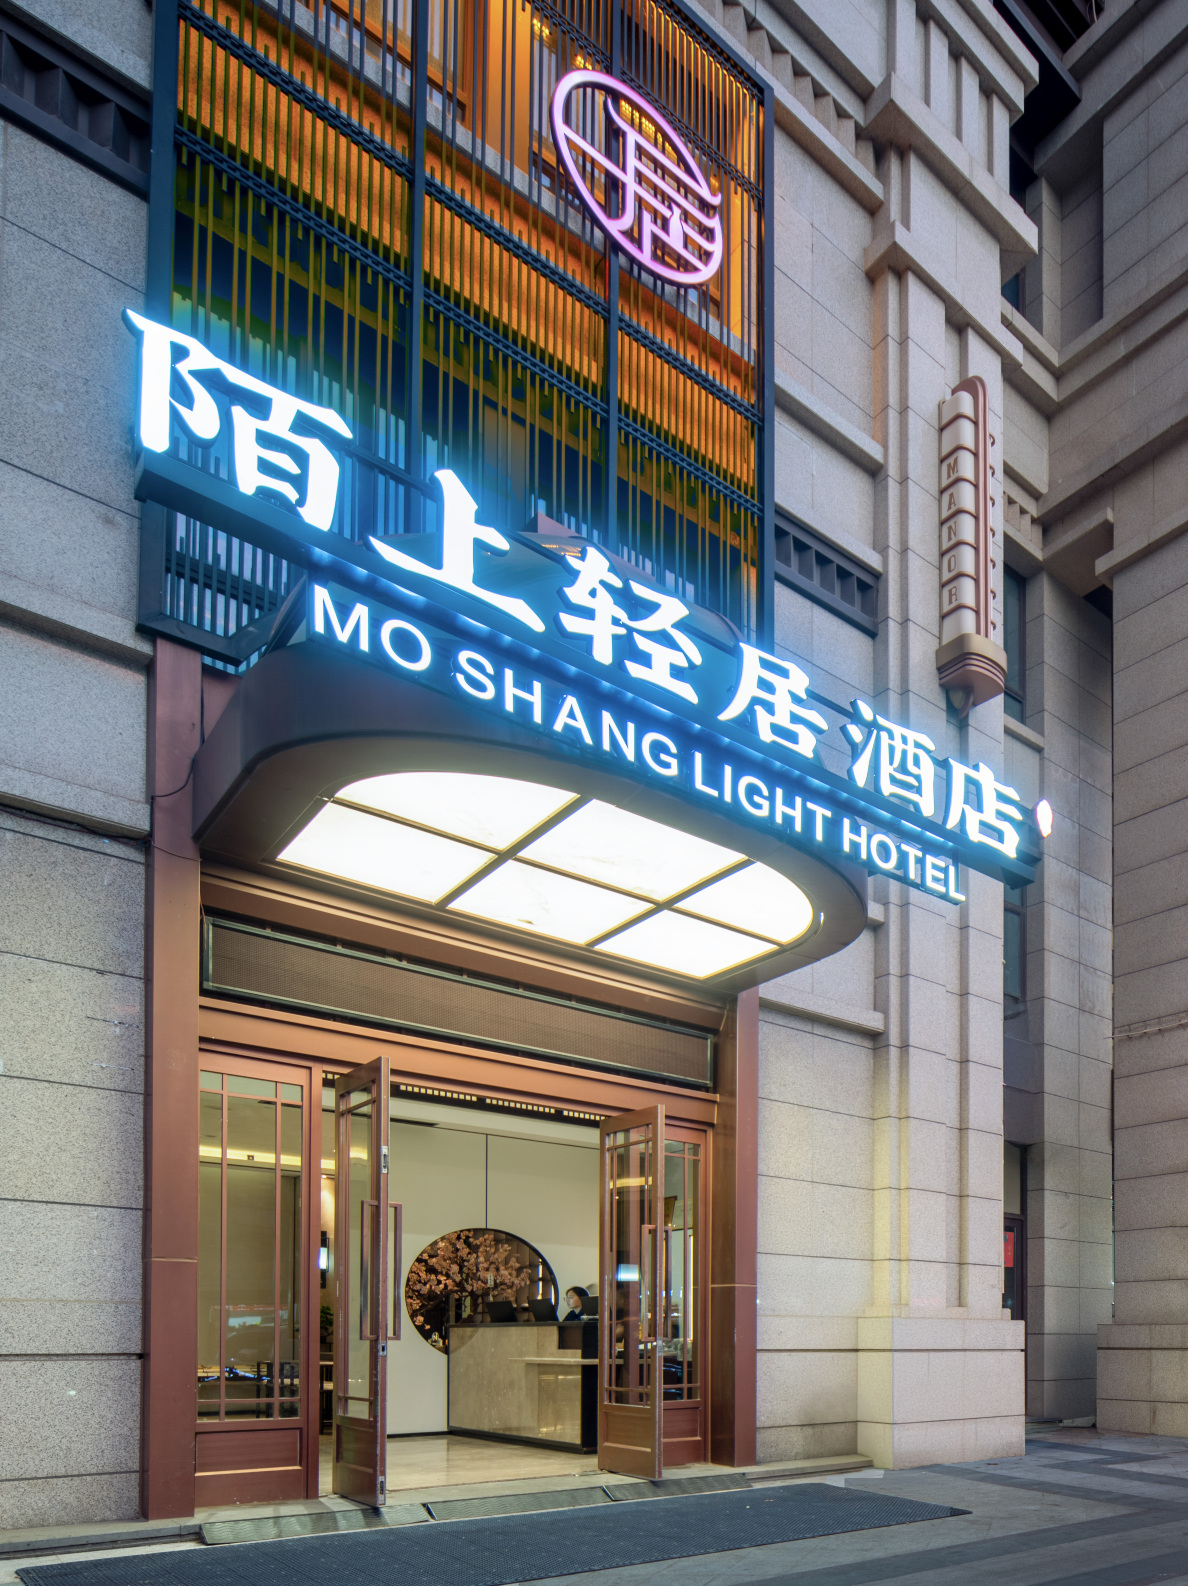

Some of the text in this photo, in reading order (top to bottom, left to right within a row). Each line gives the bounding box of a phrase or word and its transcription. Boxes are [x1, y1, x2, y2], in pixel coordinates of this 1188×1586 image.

[123, 307, 1024, 860] 陌上轻居酒店
[946, 455, 959, 606] MANOR
[312, 584, 967, 903] MO SHANG LIGHT HOTEL
